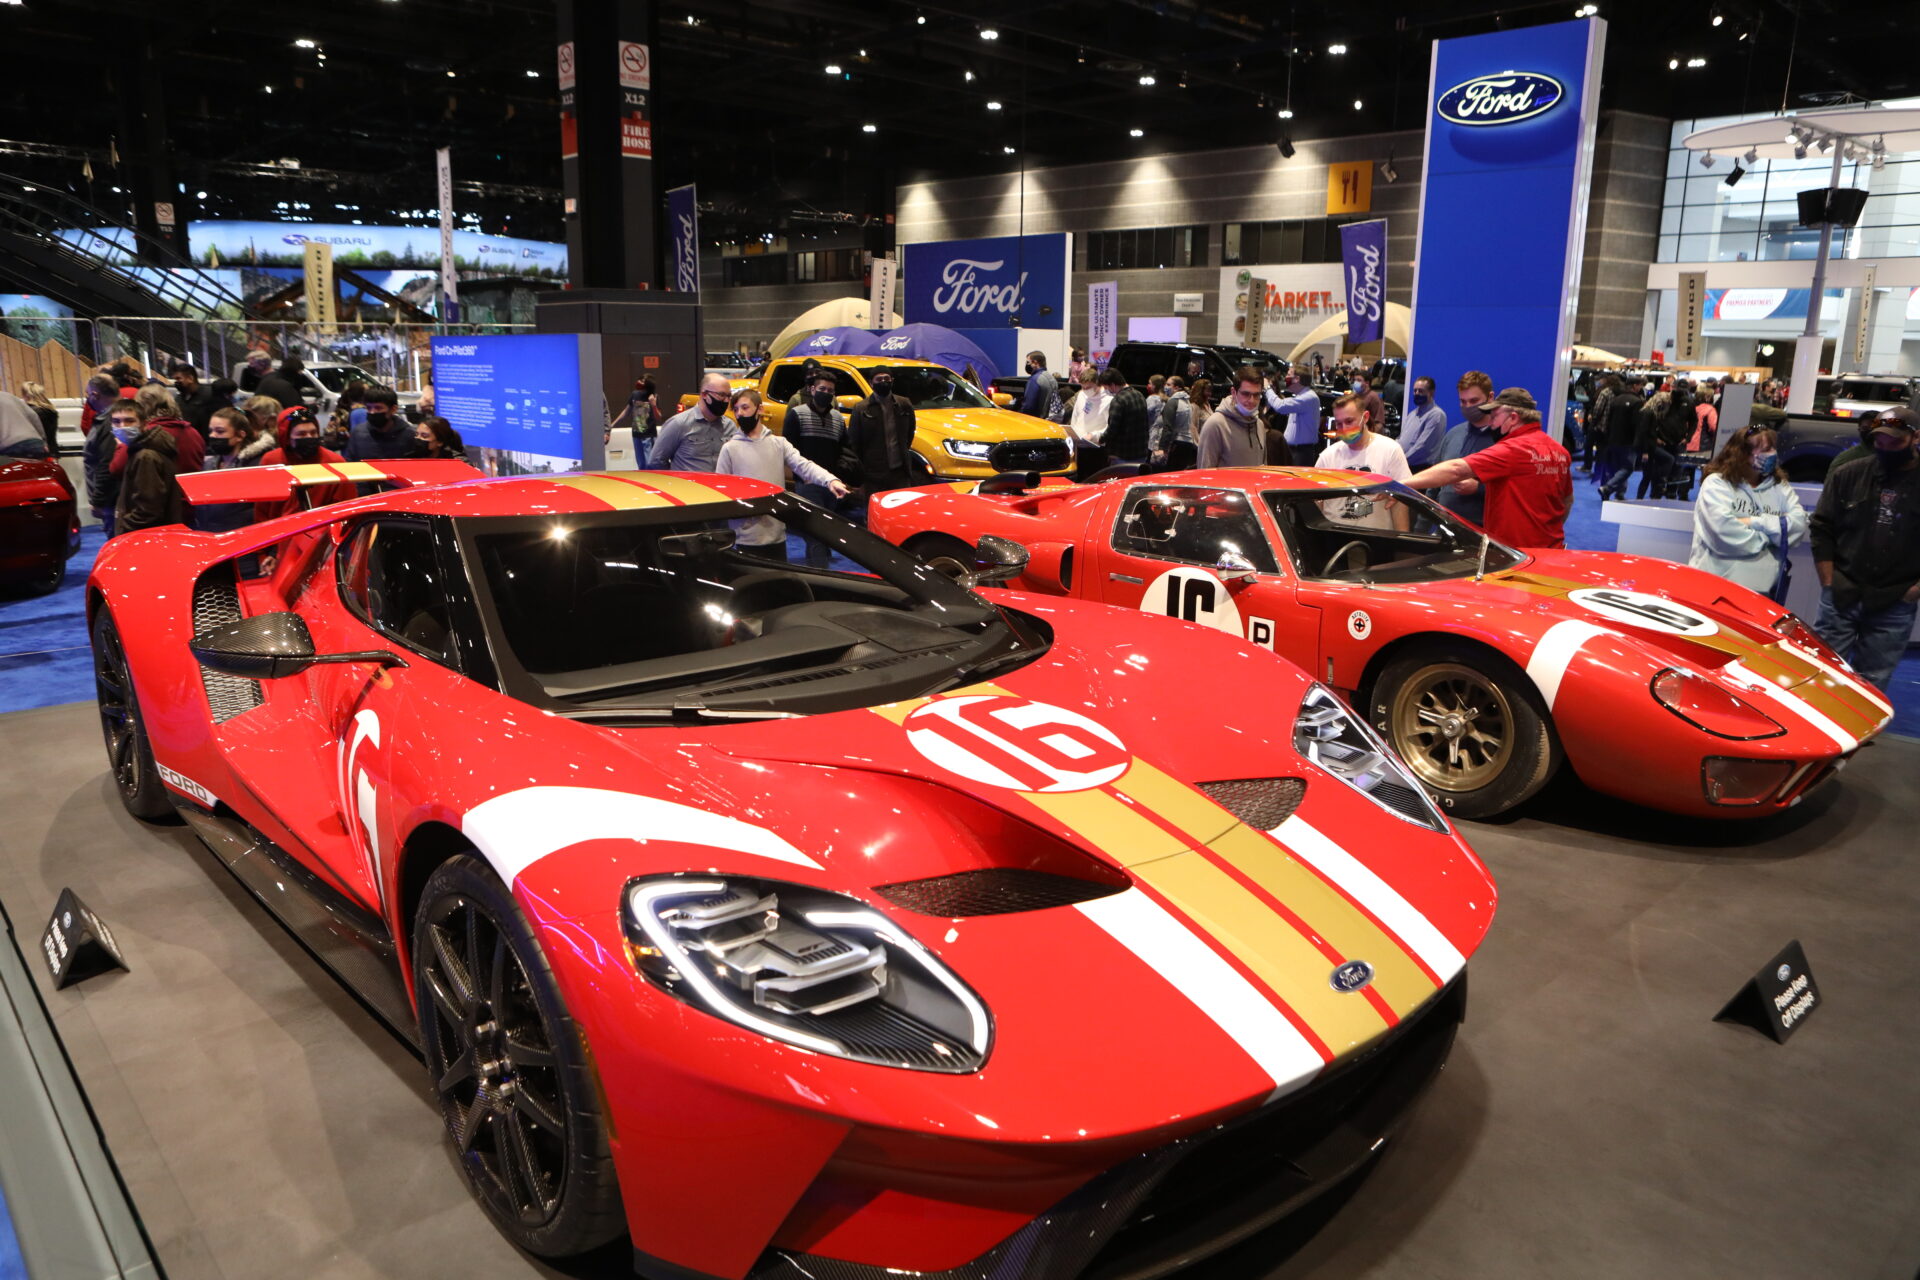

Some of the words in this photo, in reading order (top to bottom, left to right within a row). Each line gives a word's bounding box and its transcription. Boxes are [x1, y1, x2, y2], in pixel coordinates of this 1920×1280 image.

[625, 92, 646, 106] X12
[1457, 78, 1535, 117] Ford
[622, 136, 652, 150] HOSE
[623, 124, 650, 137] FIRE
[676, 213, 696, 293] Ford
[933, 258, 1029, 313] Ford
[1350, 244, 1381, 322] Ford
[1251, 313, 1259, 343] BUILT
[1686, 278, 1695, 357] BRONCO
[880, 335, 912, 350] Ford
[904, 696, 1129, 791] 16
[159, 765, 208, 802] FORD
[1339, 966, 1367, 989] Ford
